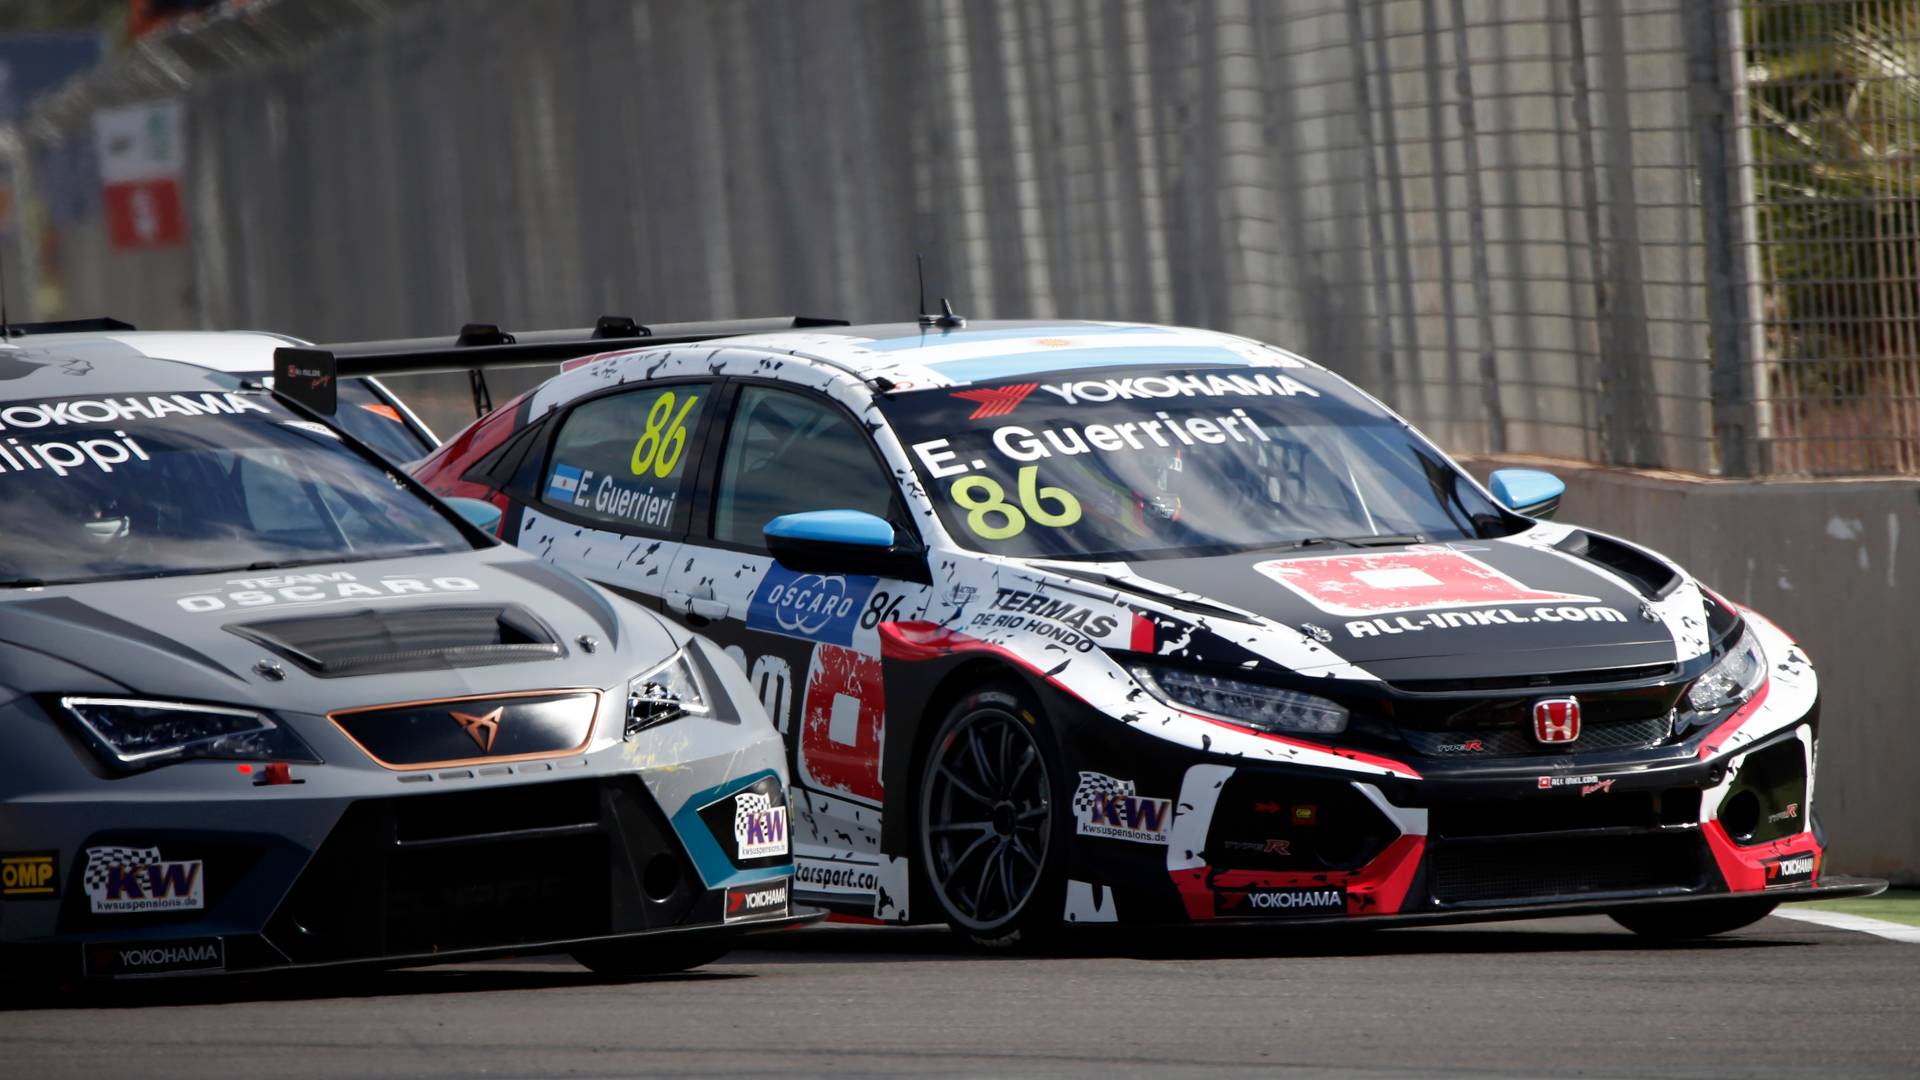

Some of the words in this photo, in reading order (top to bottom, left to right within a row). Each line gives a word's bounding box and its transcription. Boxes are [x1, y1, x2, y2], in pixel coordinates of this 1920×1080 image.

[1039, 374, 1320, 404] YOKOHAMA
[0, 393, 271, 431] OKOHAMA
[0, 430, 150, 477] lippi
[631, 392, 699, 478] 86
[911, 437, 987, 480] E.
[992, 408, 1271, 462] Guerrieri
[574, 469, 594, 508] E.
[595, 474, 677, 527] Guerrieri
[950, 465, 1083, 541] 86
[176, 576, 481, 613] OSCARO
[226, 570, 357, 590] TEAM
[767, 584, 854, 618] OSCARO
[988, 587, 1119, 639] TERMAS
[971, 612, 992, 627] DE
[992, 614, 1026, 629] RIO
[1023, 618, 1095, 653] HONDO
[746, 809, 786, 846] KW
[1090, 790, 1171, 833] KW
[1081, 822, 1167, 843] kwsuspensions.de
[2, 863, 54, 888] OMP
[105, 862, 200, 900] KW
[795, 862, 879, 890] torsport.co
[96, 897, 198, 913] kwsuspensions.de
[744, 887, 786, 909] YOKOHAMA
[1247, 890, 1342, 909] YOKOHAMA
[119, 944, 218, 967] YOKOHAMA
